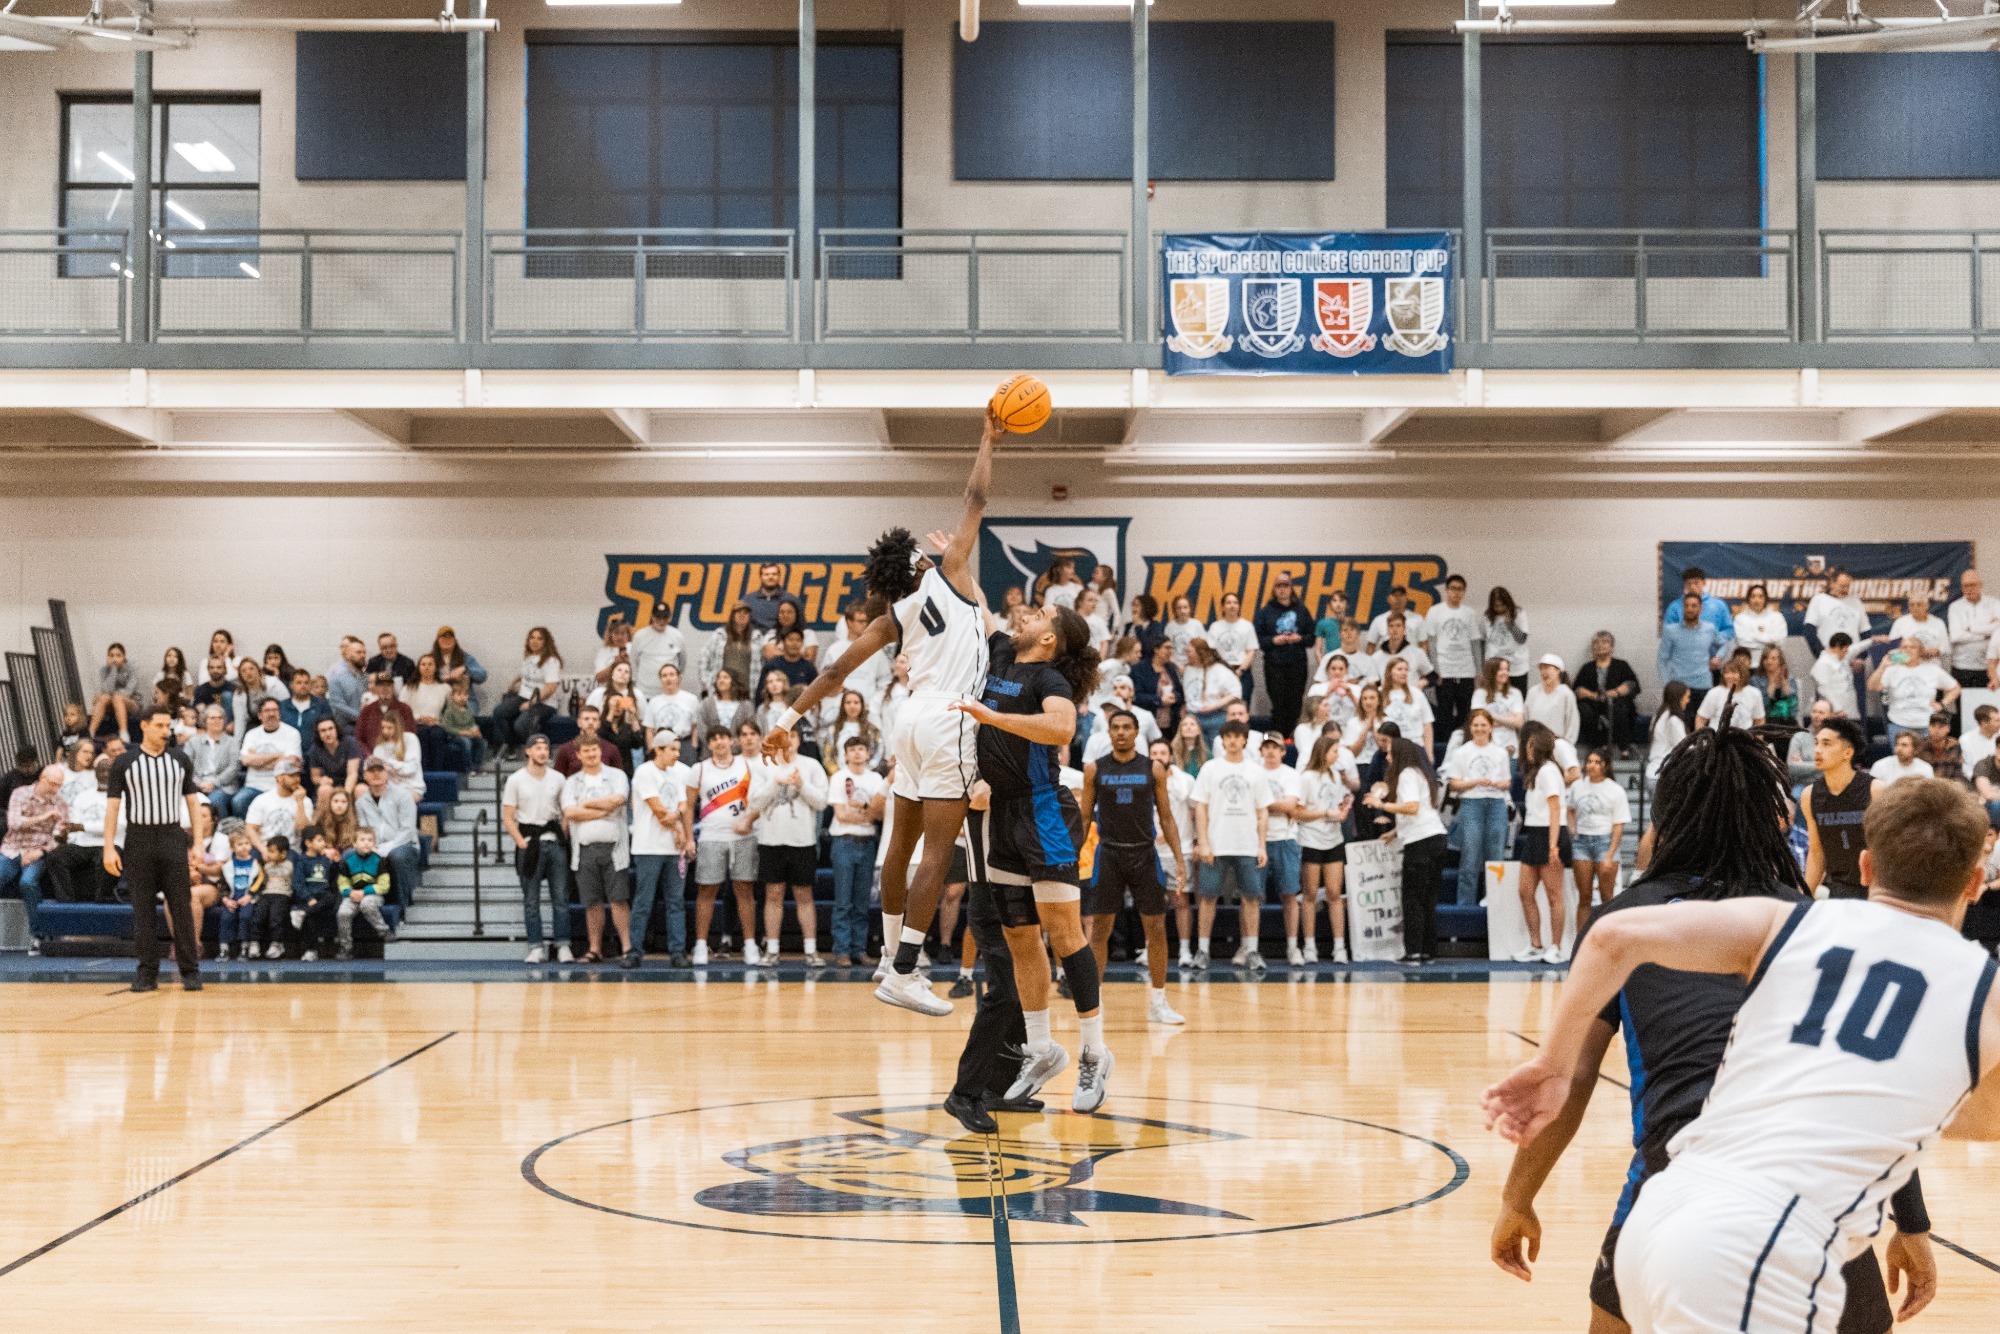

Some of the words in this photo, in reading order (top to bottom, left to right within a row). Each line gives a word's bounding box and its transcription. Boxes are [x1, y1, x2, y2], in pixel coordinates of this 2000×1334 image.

[1165, 250, 1196, 274] THE
[1197, 250, 1281, 274] SPURGEON
[1282, 250, 1348, 273] COLLEGE
[1349, 249, 1413, 273] COHORT
[1413, 249, 1448, 272] CUP
[919, 595, 946, 637] 0
[706, 777, 738, 800] SUNS
[729, 800, 746, 816] 34
[1841, 830, 1850, 849] 1
[1357, 889, 1385, 908] OUT
[1789, 945, 1928, 1062] 10
